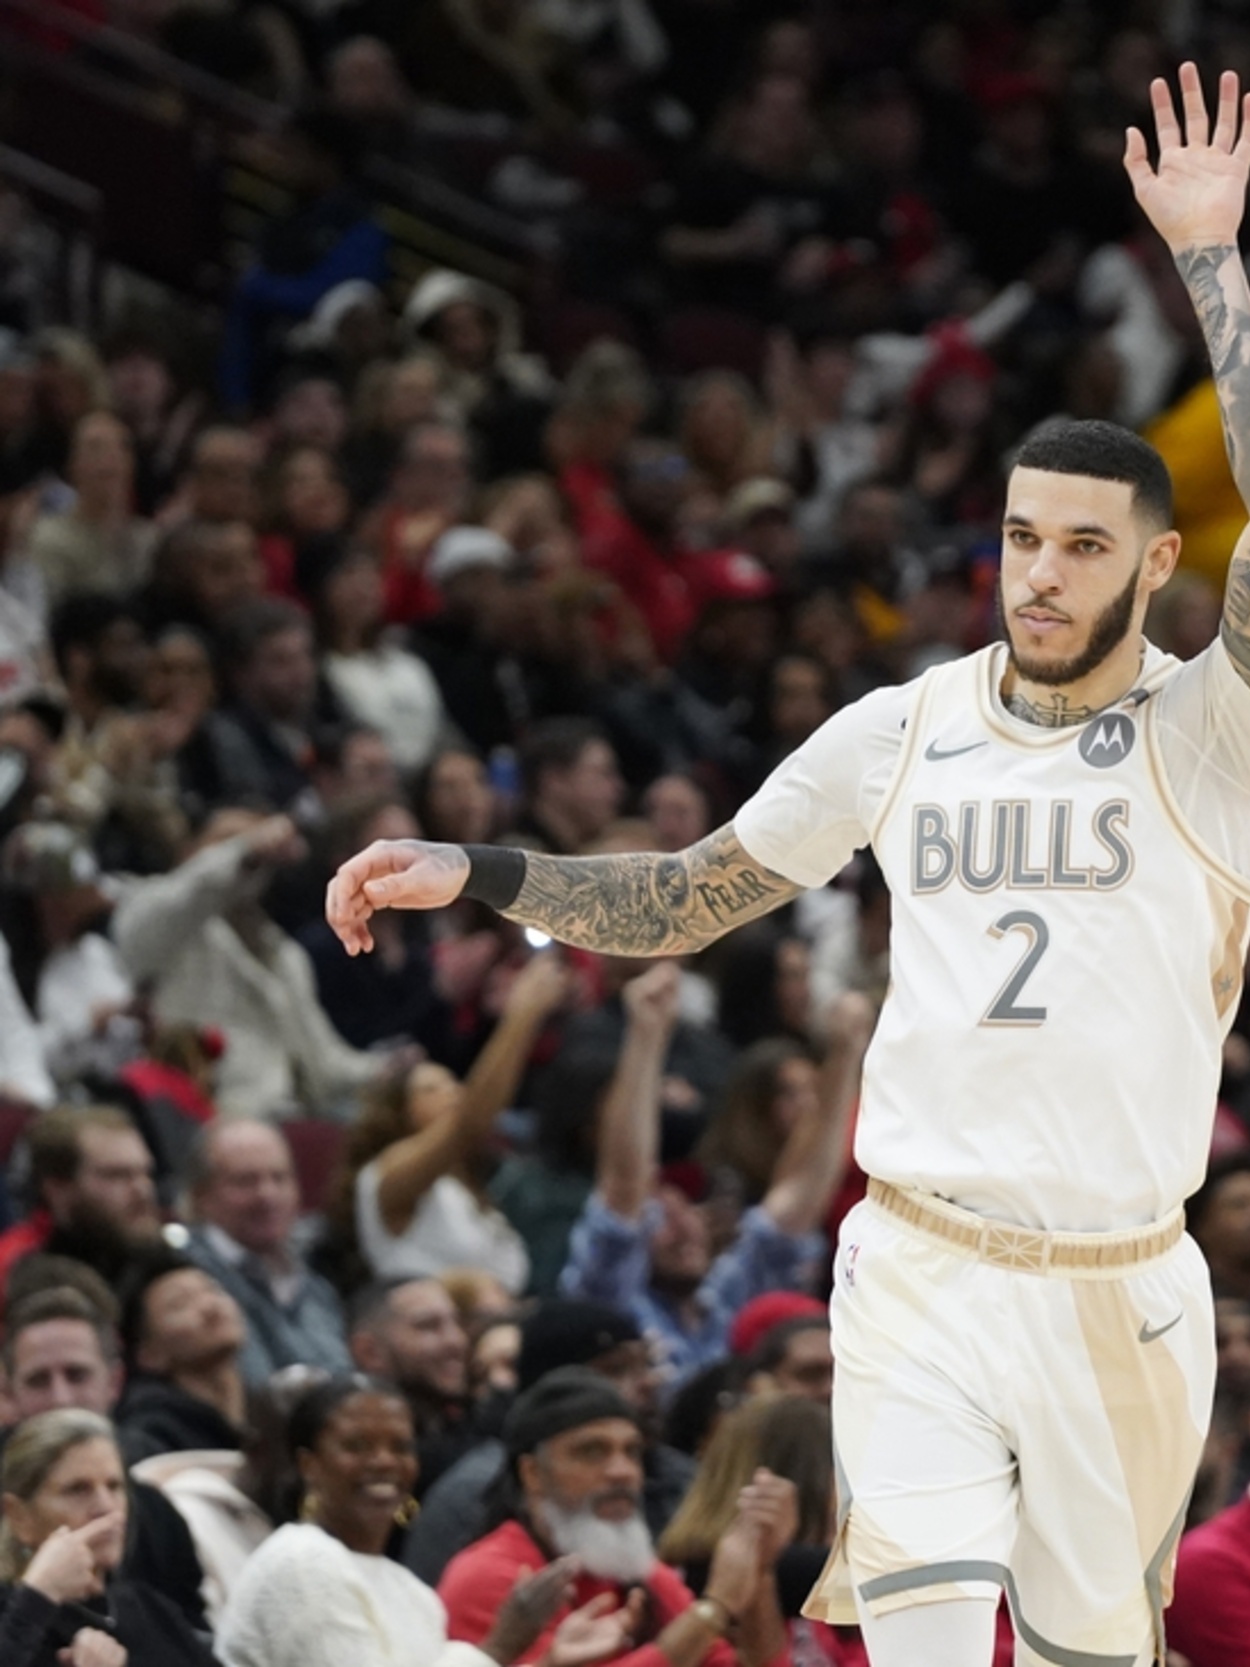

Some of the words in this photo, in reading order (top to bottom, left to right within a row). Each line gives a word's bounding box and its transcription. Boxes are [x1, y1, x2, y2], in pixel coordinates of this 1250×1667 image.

[911, 799, 1135, 895] BULLS
[696, 868, 777, 925] FEAR
[977, 910, 1050, 1028] 2
